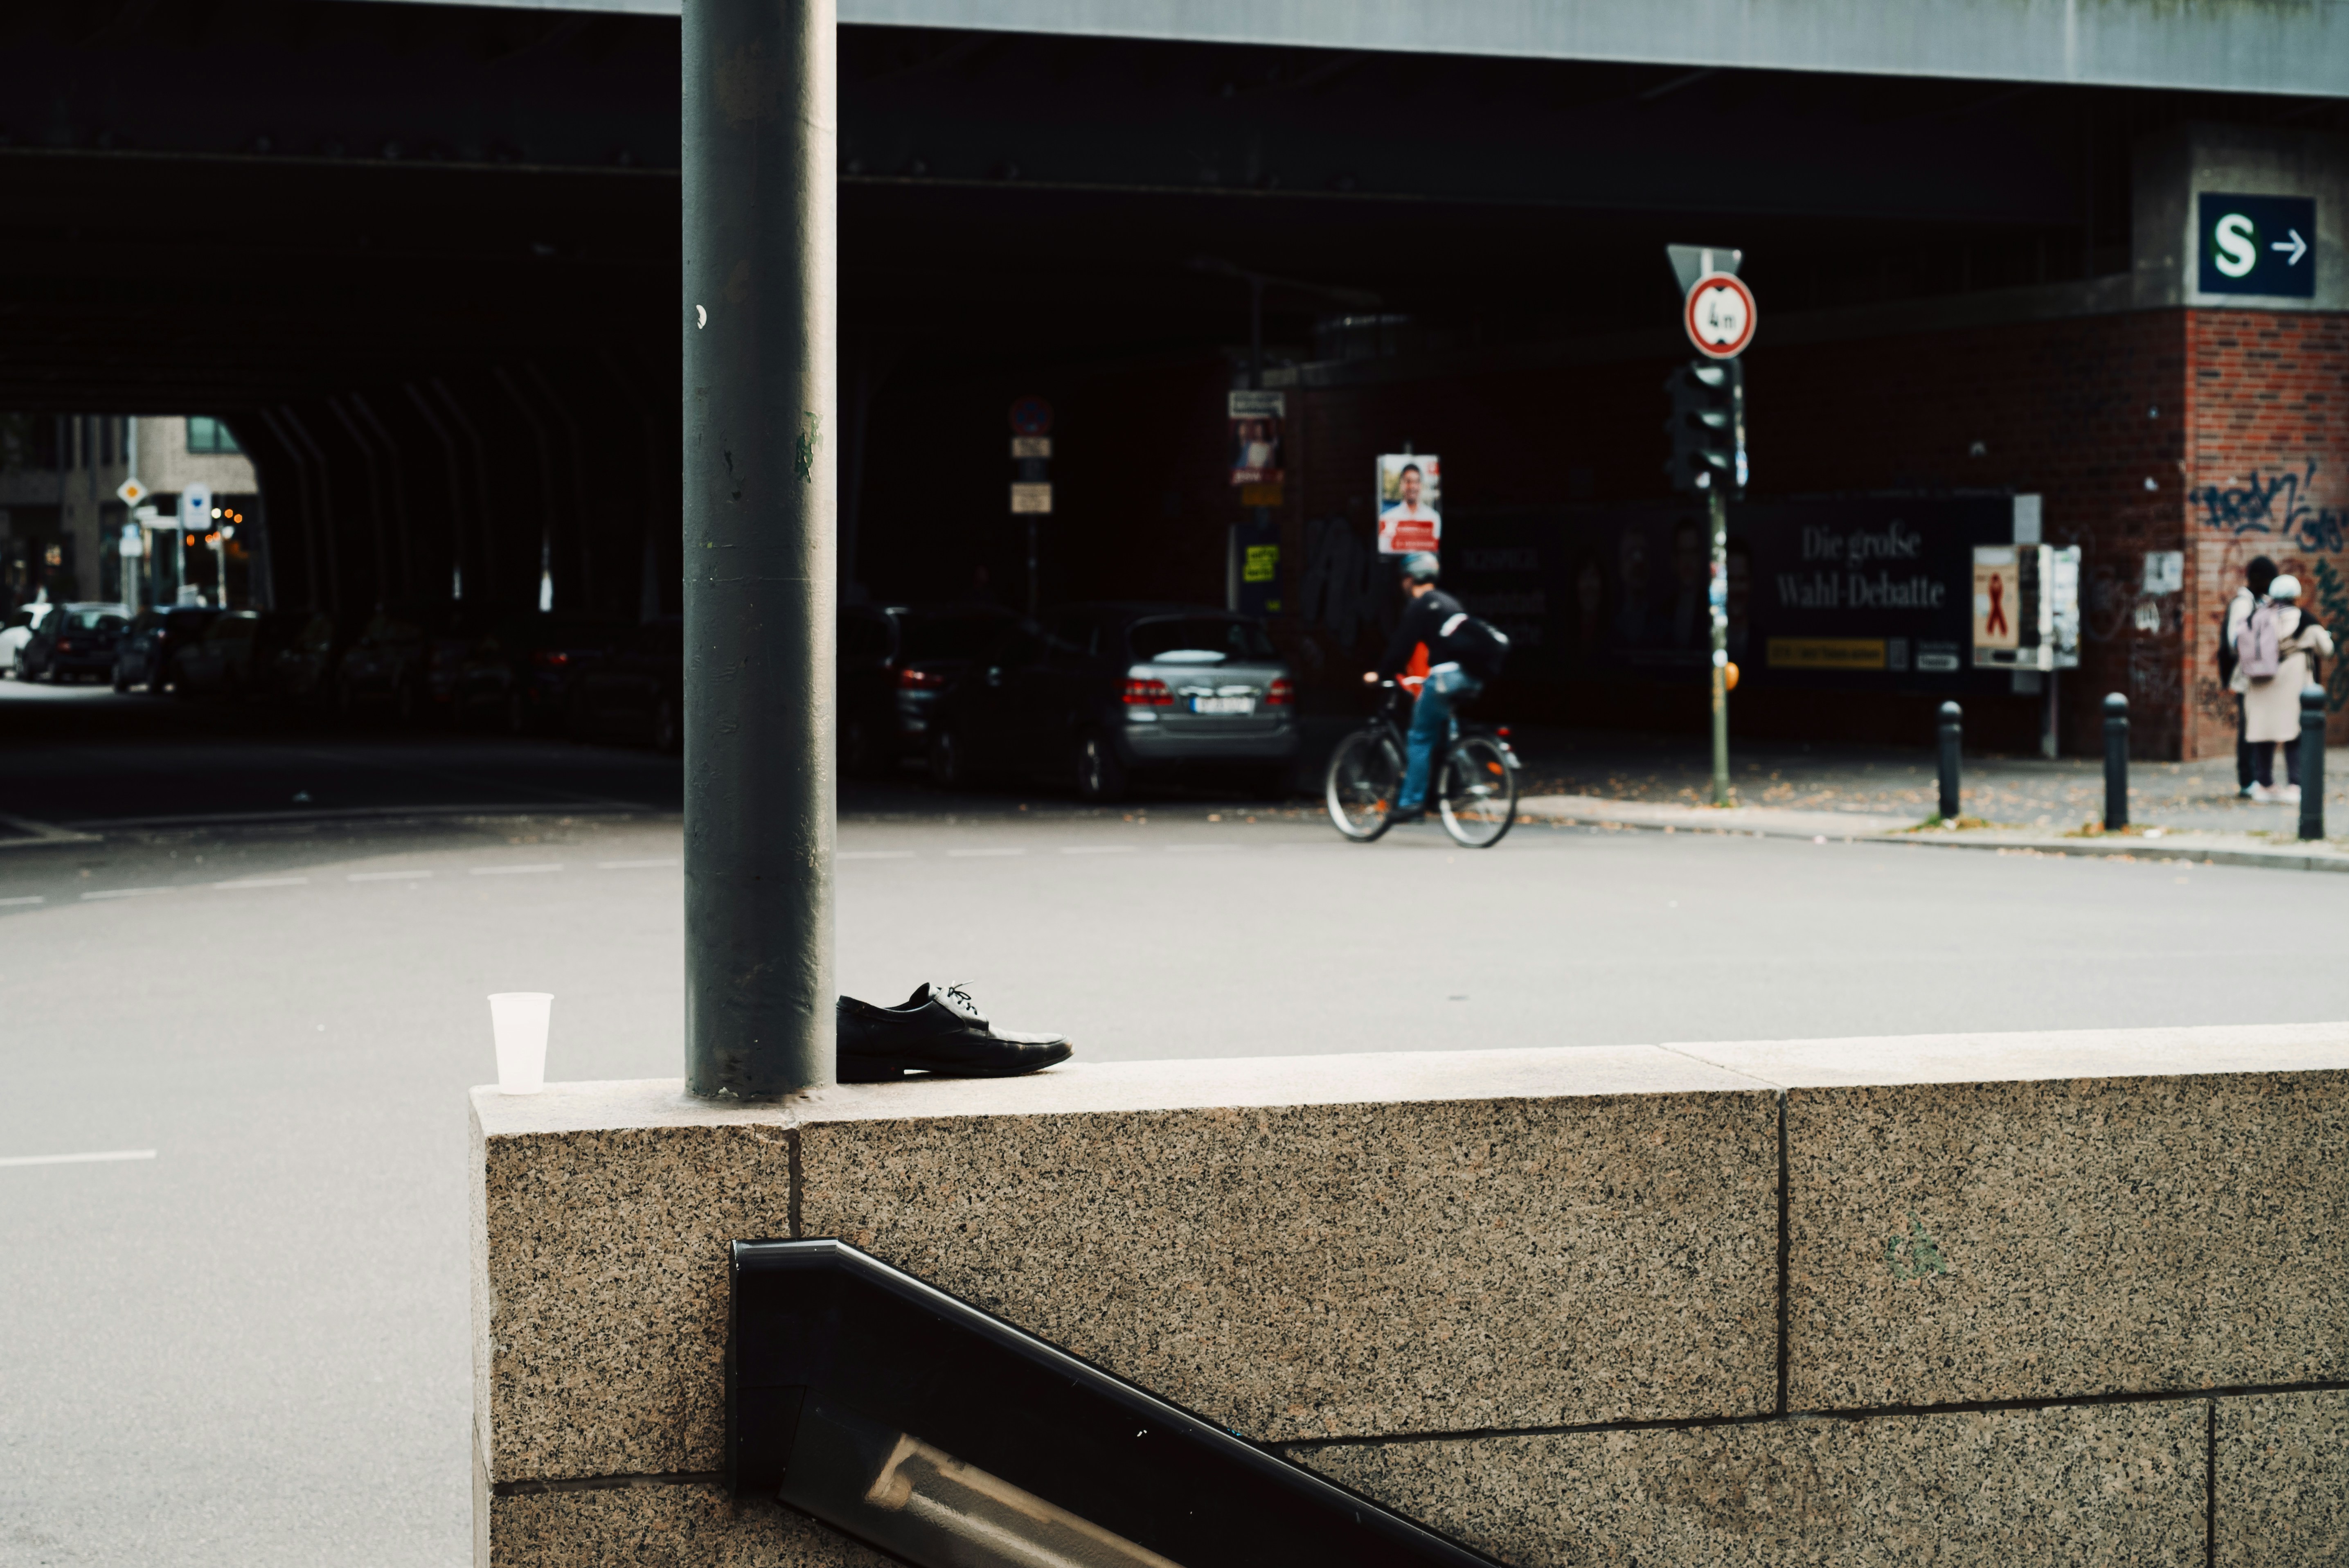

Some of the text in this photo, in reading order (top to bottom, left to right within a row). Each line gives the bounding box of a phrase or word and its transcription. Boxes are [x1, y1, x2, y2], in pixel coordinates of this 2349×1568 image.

[2214, 213, 2257, 278] S
[1802, 518, 1922, 569] Die große
[1776, 568, 1946, 609] Wahl-Debatte
